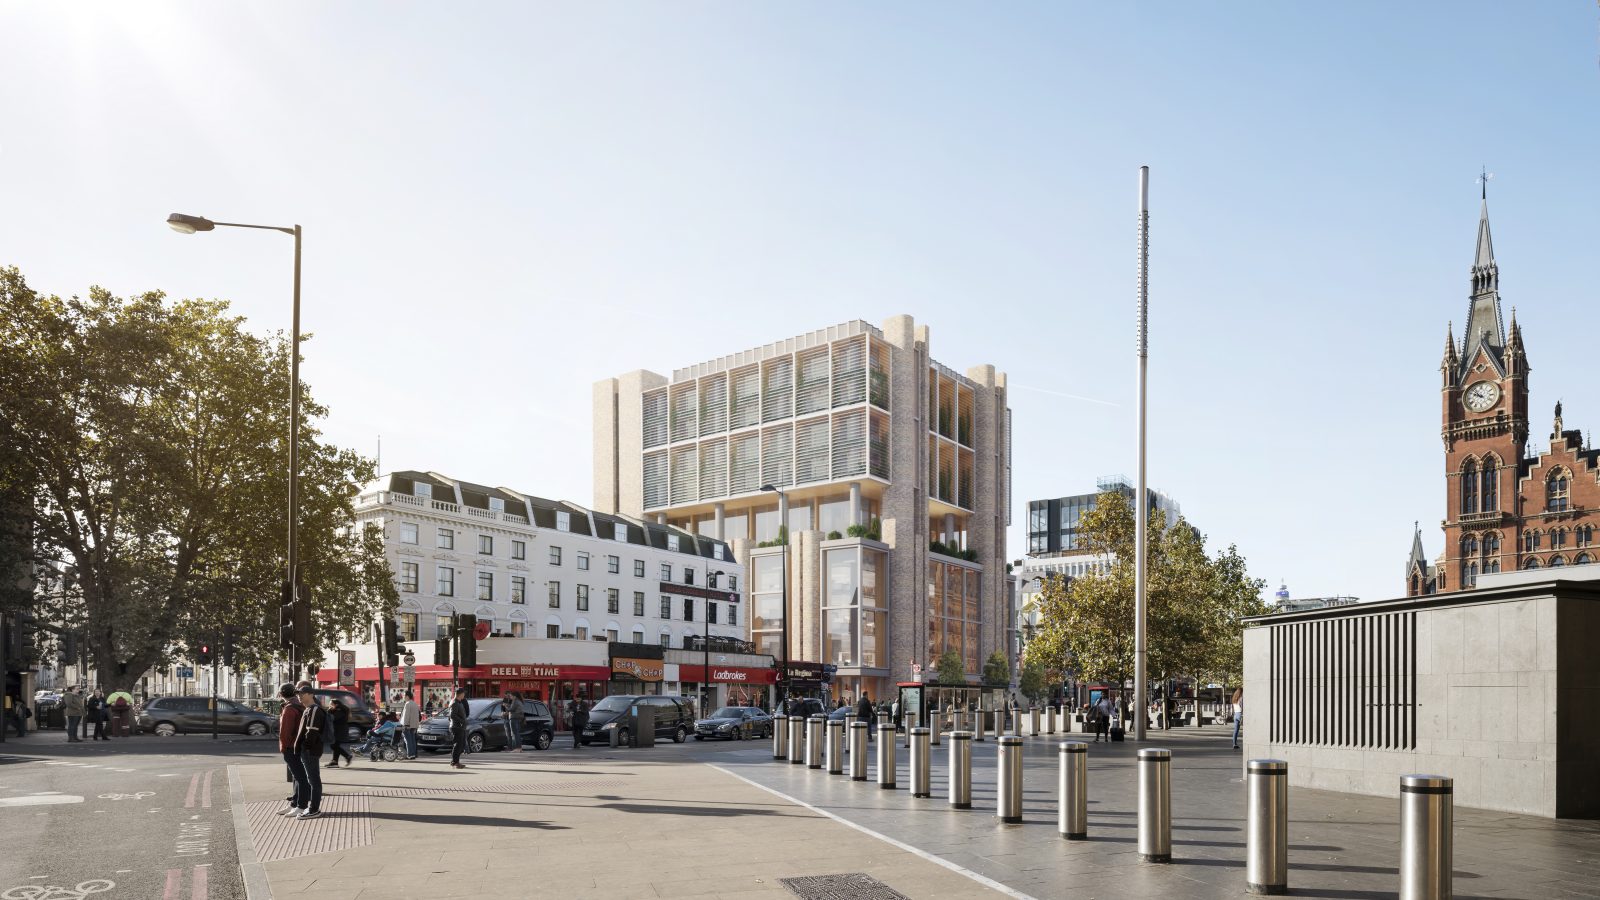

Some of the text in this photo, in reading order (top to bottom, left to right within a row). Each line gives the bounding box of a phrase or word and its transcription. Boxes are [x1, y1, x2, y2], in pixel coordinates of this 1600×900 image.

[491, 667, 559, 676] REEL TIME
[713, 669, 747, 680] Ladbrokes
[787, 668, 794, 676] La
